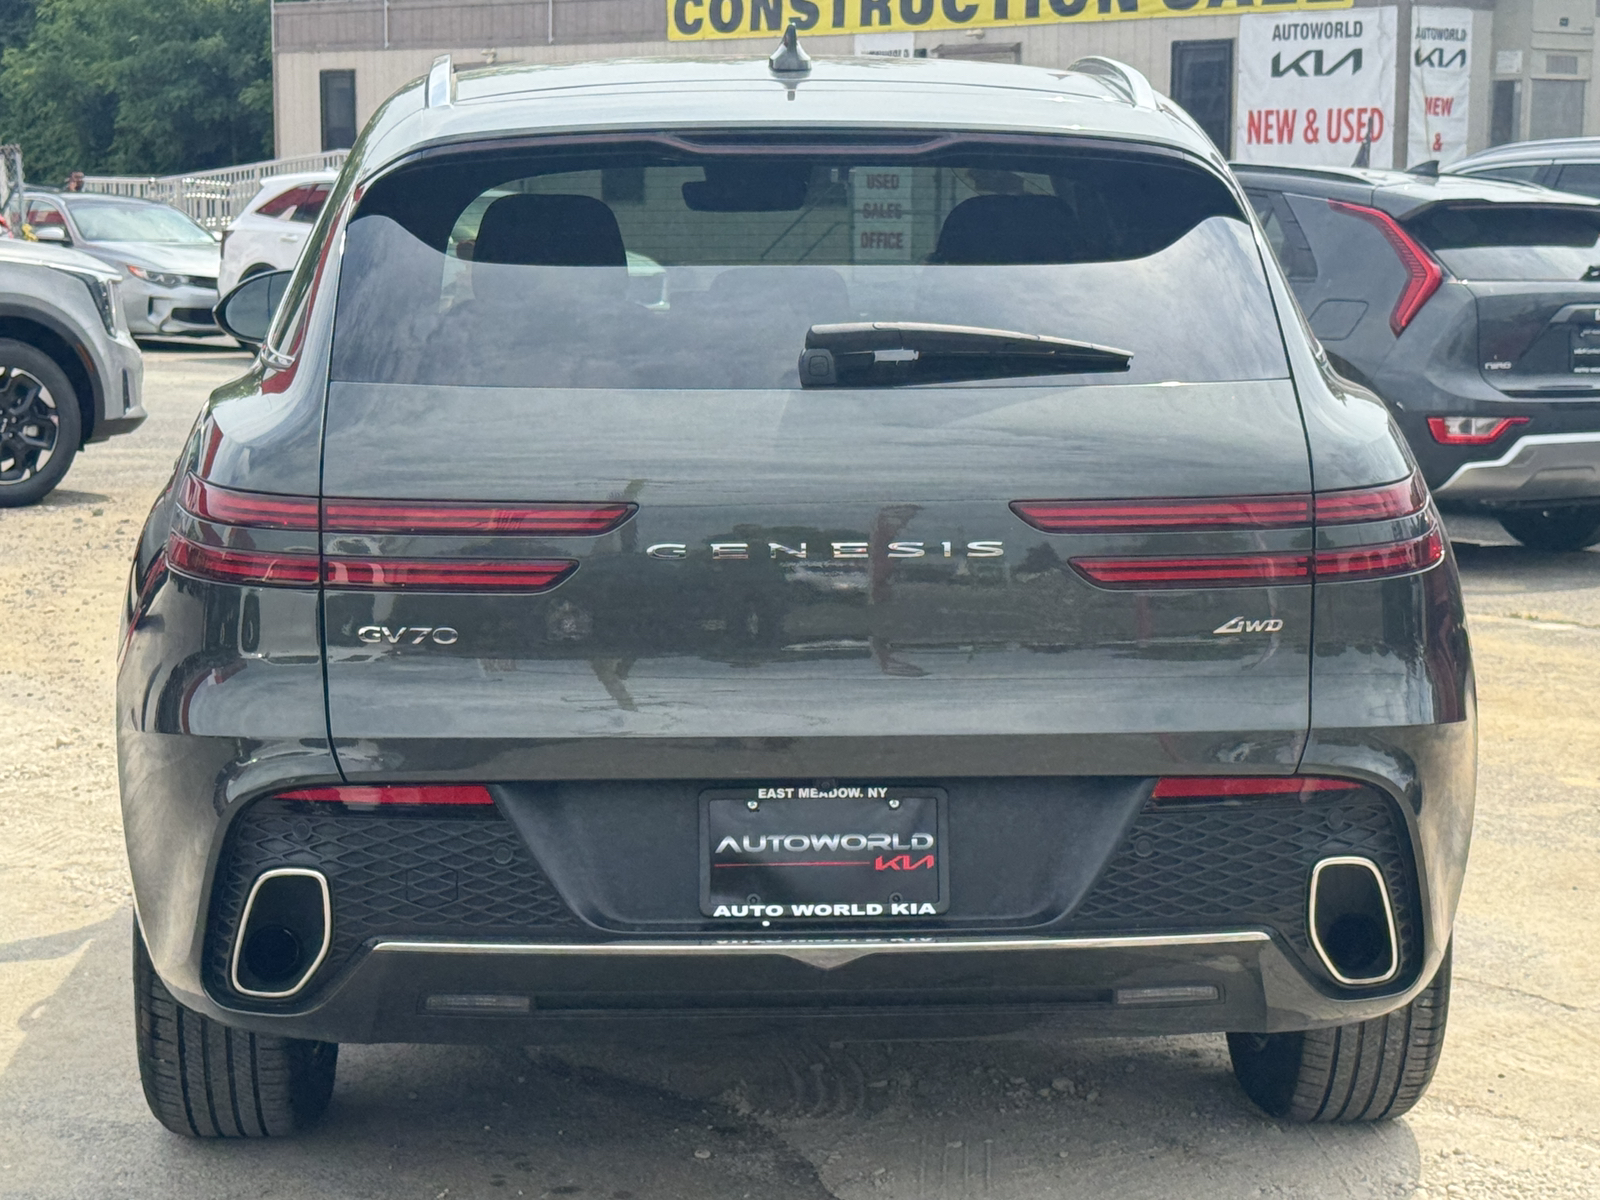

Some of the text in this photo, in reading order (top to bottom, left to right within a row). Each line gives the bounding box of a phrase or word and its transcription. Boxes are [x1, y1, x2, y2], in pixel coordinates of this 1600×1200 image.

[1272, 20, 1363, 42] AUTOWORLD
[1415, 27, 1467, 42] AUTOWORLD
[1425, 97, 1454, 116] NEW
[1247, 107, 1384, 144] NEW & USED
[1432, 133, 1443, 152] &
[866, 174, 900, 190] USED
[863, 203, 902, 219] SALES
[860, 232, 903, 250] OFFICE
[646, 541, 1005, 560] GENESIS
[357, 625, 459, 645] GV70
[758, 788, 795, 799] EAST
[867, 787, 888, 798] NY
[715, 832, 934, 853] AUTOWORLD
[713, 903, 936, 917] AUTO WORLD KIA
